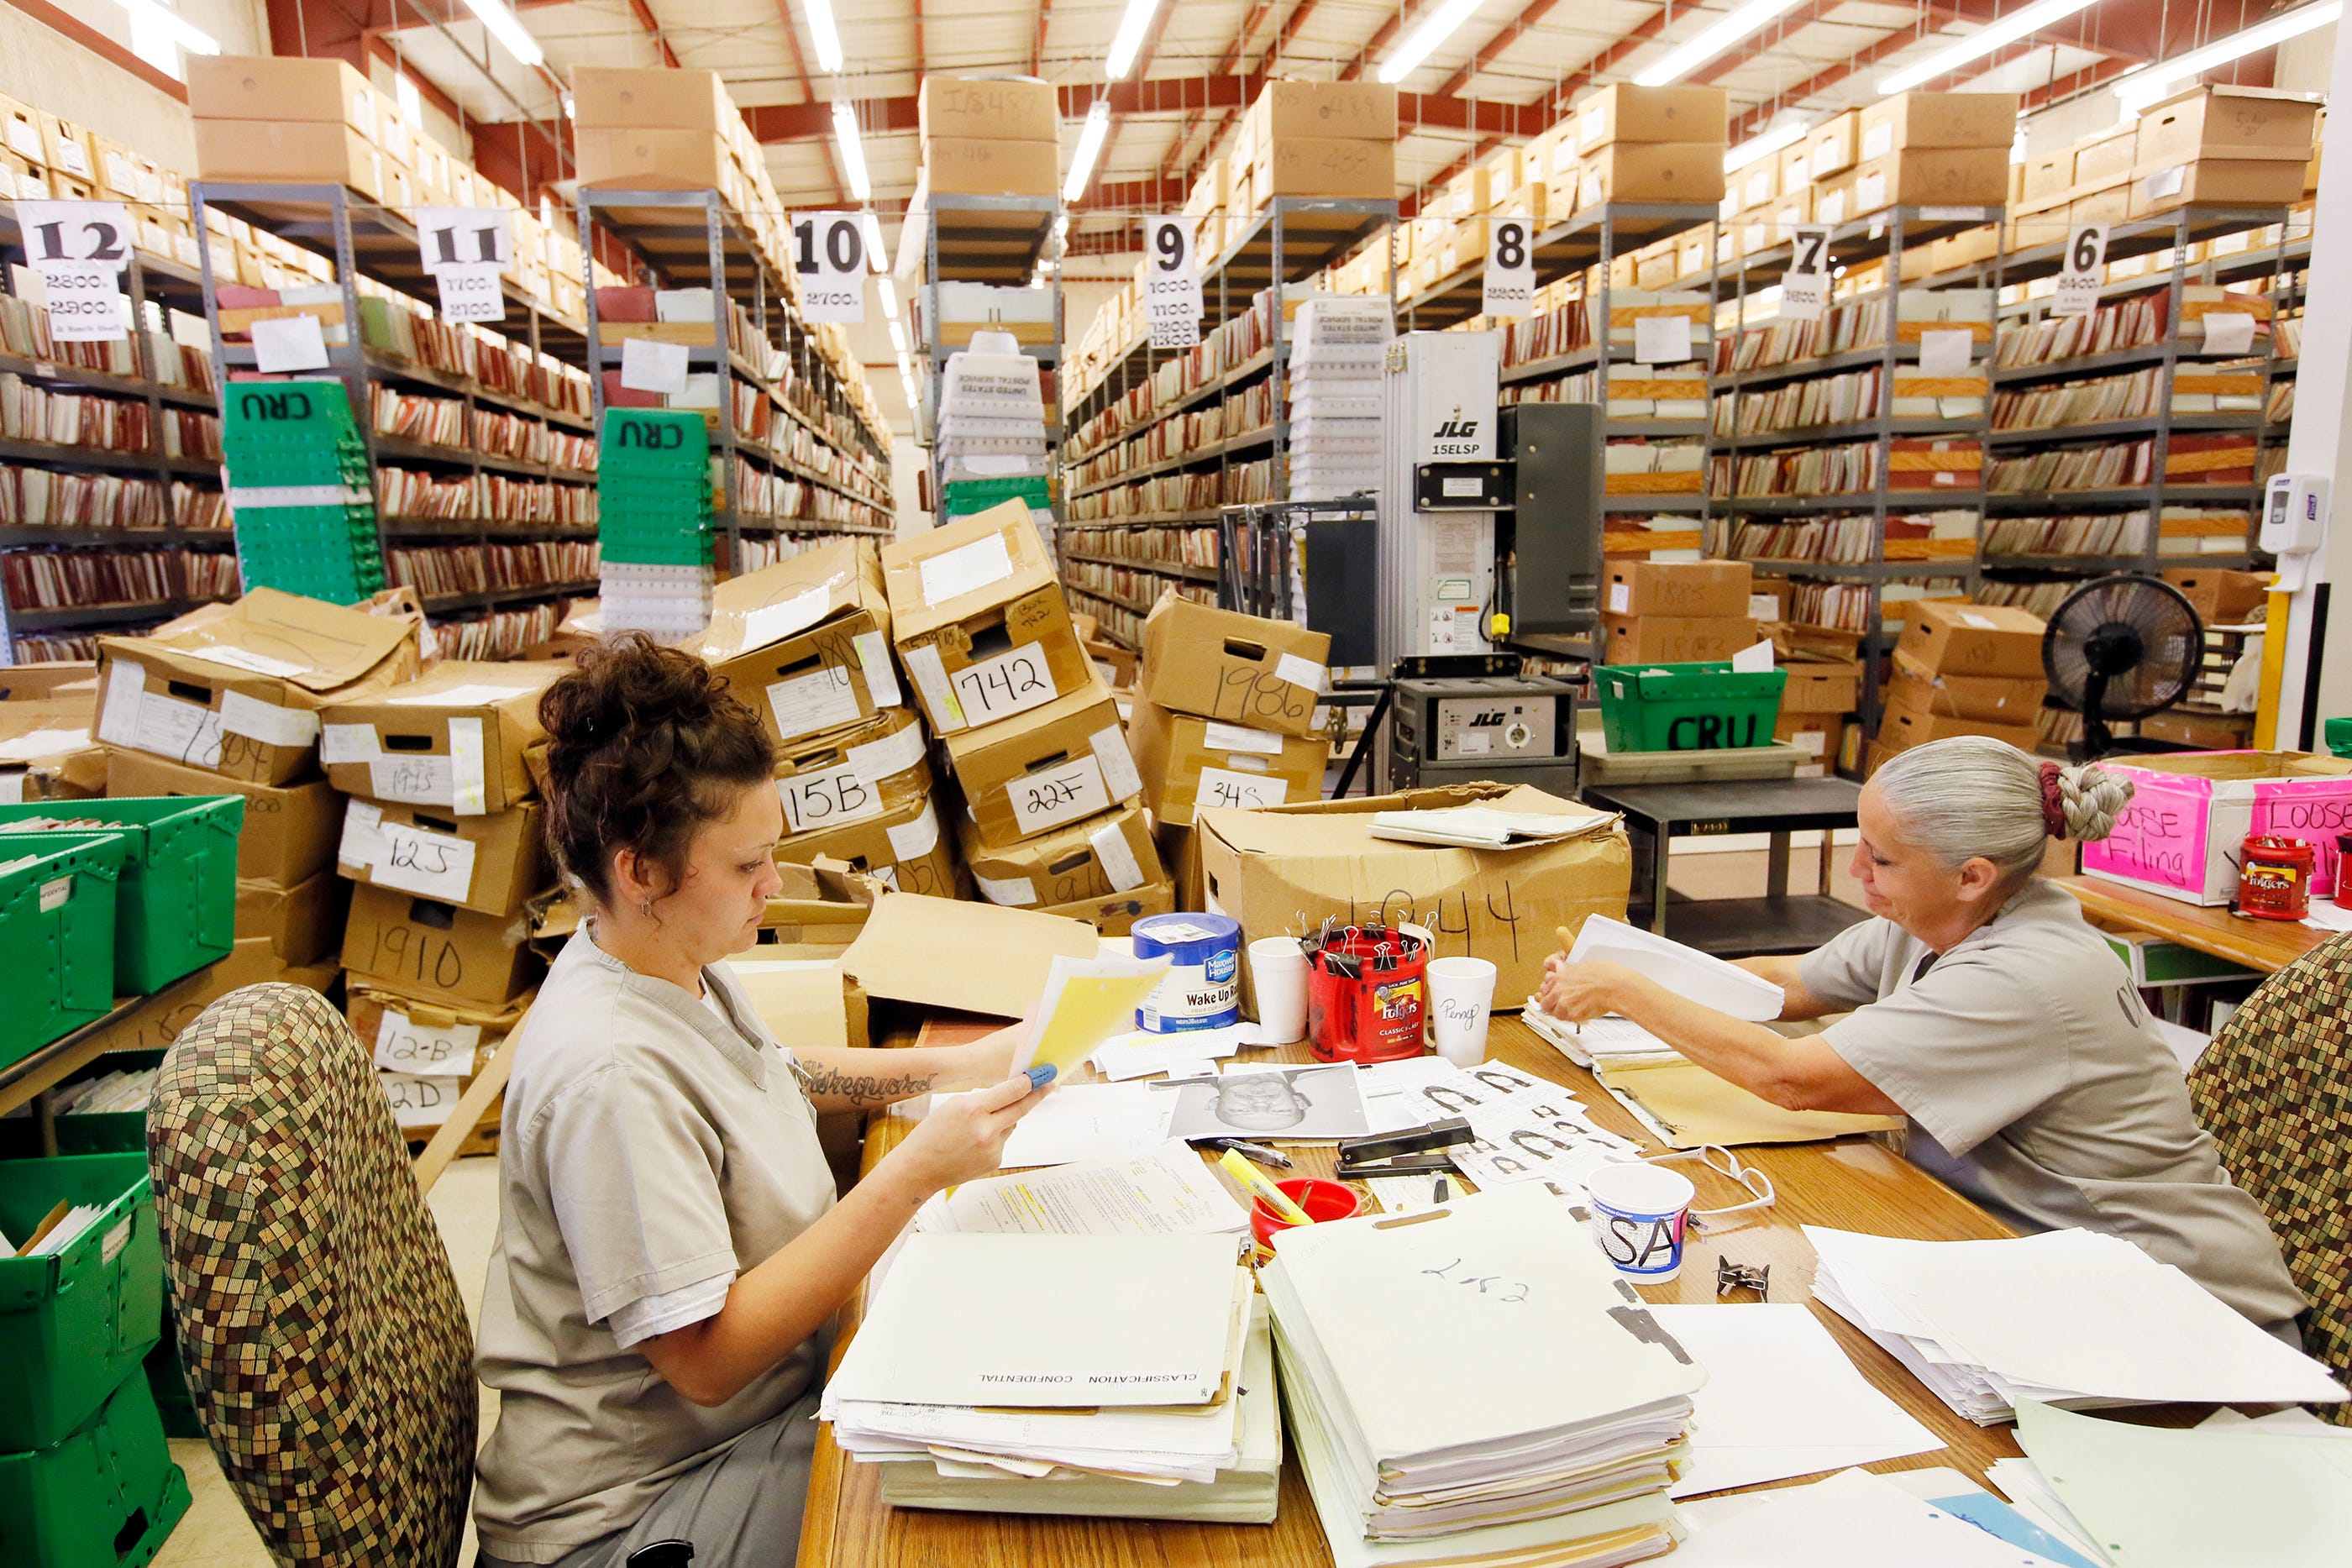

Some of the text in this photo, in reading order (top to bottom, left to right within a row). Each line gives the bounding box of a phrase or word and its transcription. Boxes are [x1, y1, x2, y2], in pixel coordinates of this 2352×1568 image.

[34, 221, 126, 260] 12
[430, 225, 507, 265] 11
[795, 220, 862, 274] 10
[1157, 223, 1184, 272] 9
[1497, 223, 1525, 270] 8
[1797, 232, 1826, 275] 7
[2074, 228, 2099, 273] 6
[240, 391, 312, 421] CRU
[618, 421, 684, 450] CRU
[1431, 443, 1480, 455] 15ELSP
[1433, 422, 1478, 438] JLG
[1021, 609, 1051, 628] 742
[961, 658, 1047, 711] 742
[1212, 665, 1305, 720] 1986
[1468, 712, 1507, 728] JLG
[1667, 714, 1757, 751] CRU
[790, 774, 868, 828] 15B
[1027, 772, 1084, 814] 22F
[390, 837, 459, 874] 12J
[2108, 836, 2187, 886] Filing
[370, 924, 462, 989] 1910
[1186, 992, 1216, 1006] Wake
[1218, 989, 1230, 1002] Up
[1378, 1026, 1405, 1036] CLASSIC
[979, 1373, 1198, 1384] CLASSIFICATION CONFIDENTIAL
